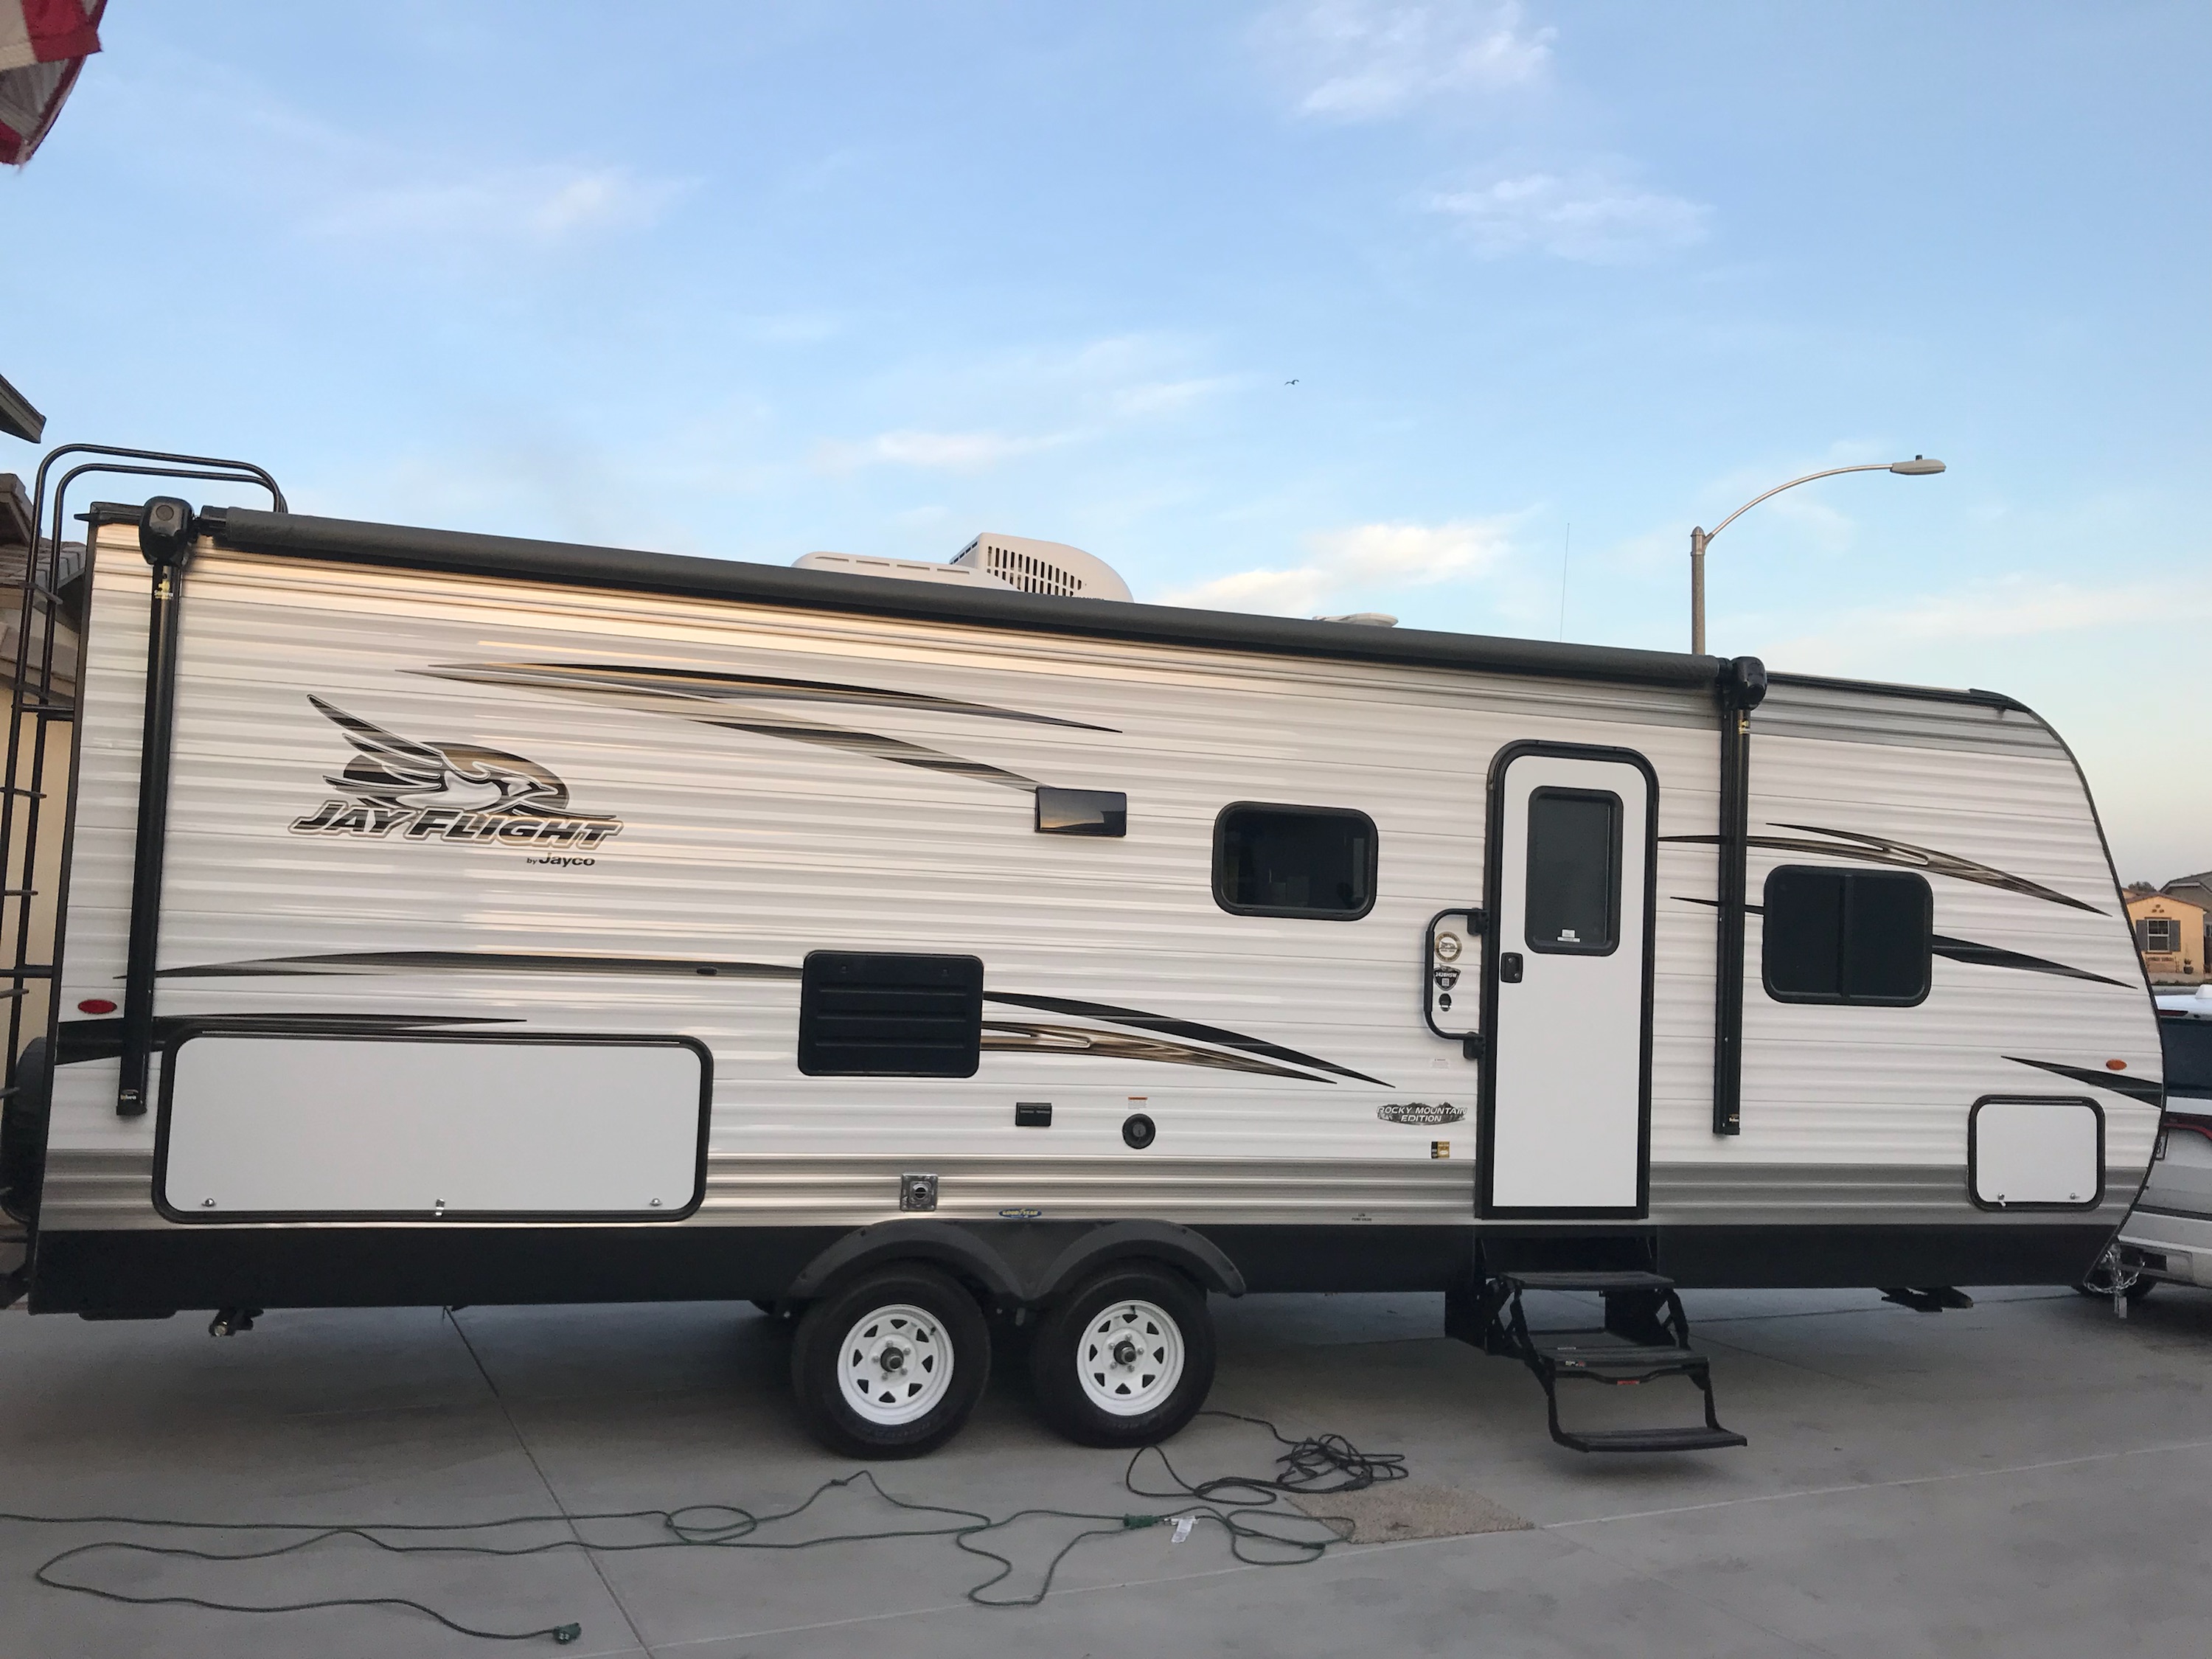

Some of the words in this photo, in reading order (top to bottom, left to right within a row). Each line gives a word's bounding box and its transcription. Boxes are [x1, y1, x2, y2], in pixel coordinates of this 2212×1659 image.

[288, 800, 414, 838] JAY
[403, 807, 624, 849] FLIGHT
[538, 852, 596, 868] Jayco
[1377, 1106, 1413, 1114] ROCKY
[1415, 1107, 1468, 1115] MOUNTAIN
[1401, 1114, 1441, 1122] EDITION
